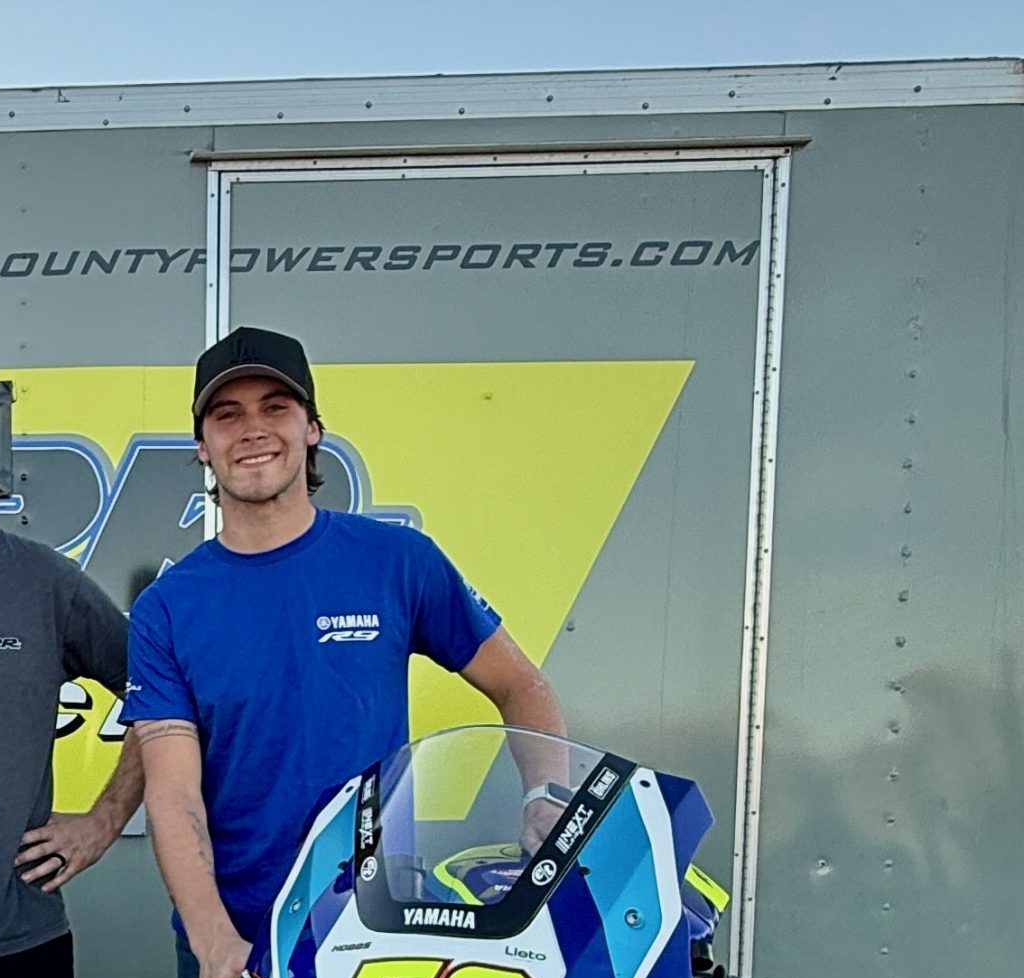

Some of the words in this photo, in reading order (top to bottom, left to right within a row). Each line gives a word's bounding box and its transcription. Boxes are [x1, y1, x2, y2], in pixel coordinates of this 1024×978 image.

[331, 614, 380, 629] YAMAHA
[318, 630, 380, 643] R9
[403, 908, 476, 929] YAMAHA
